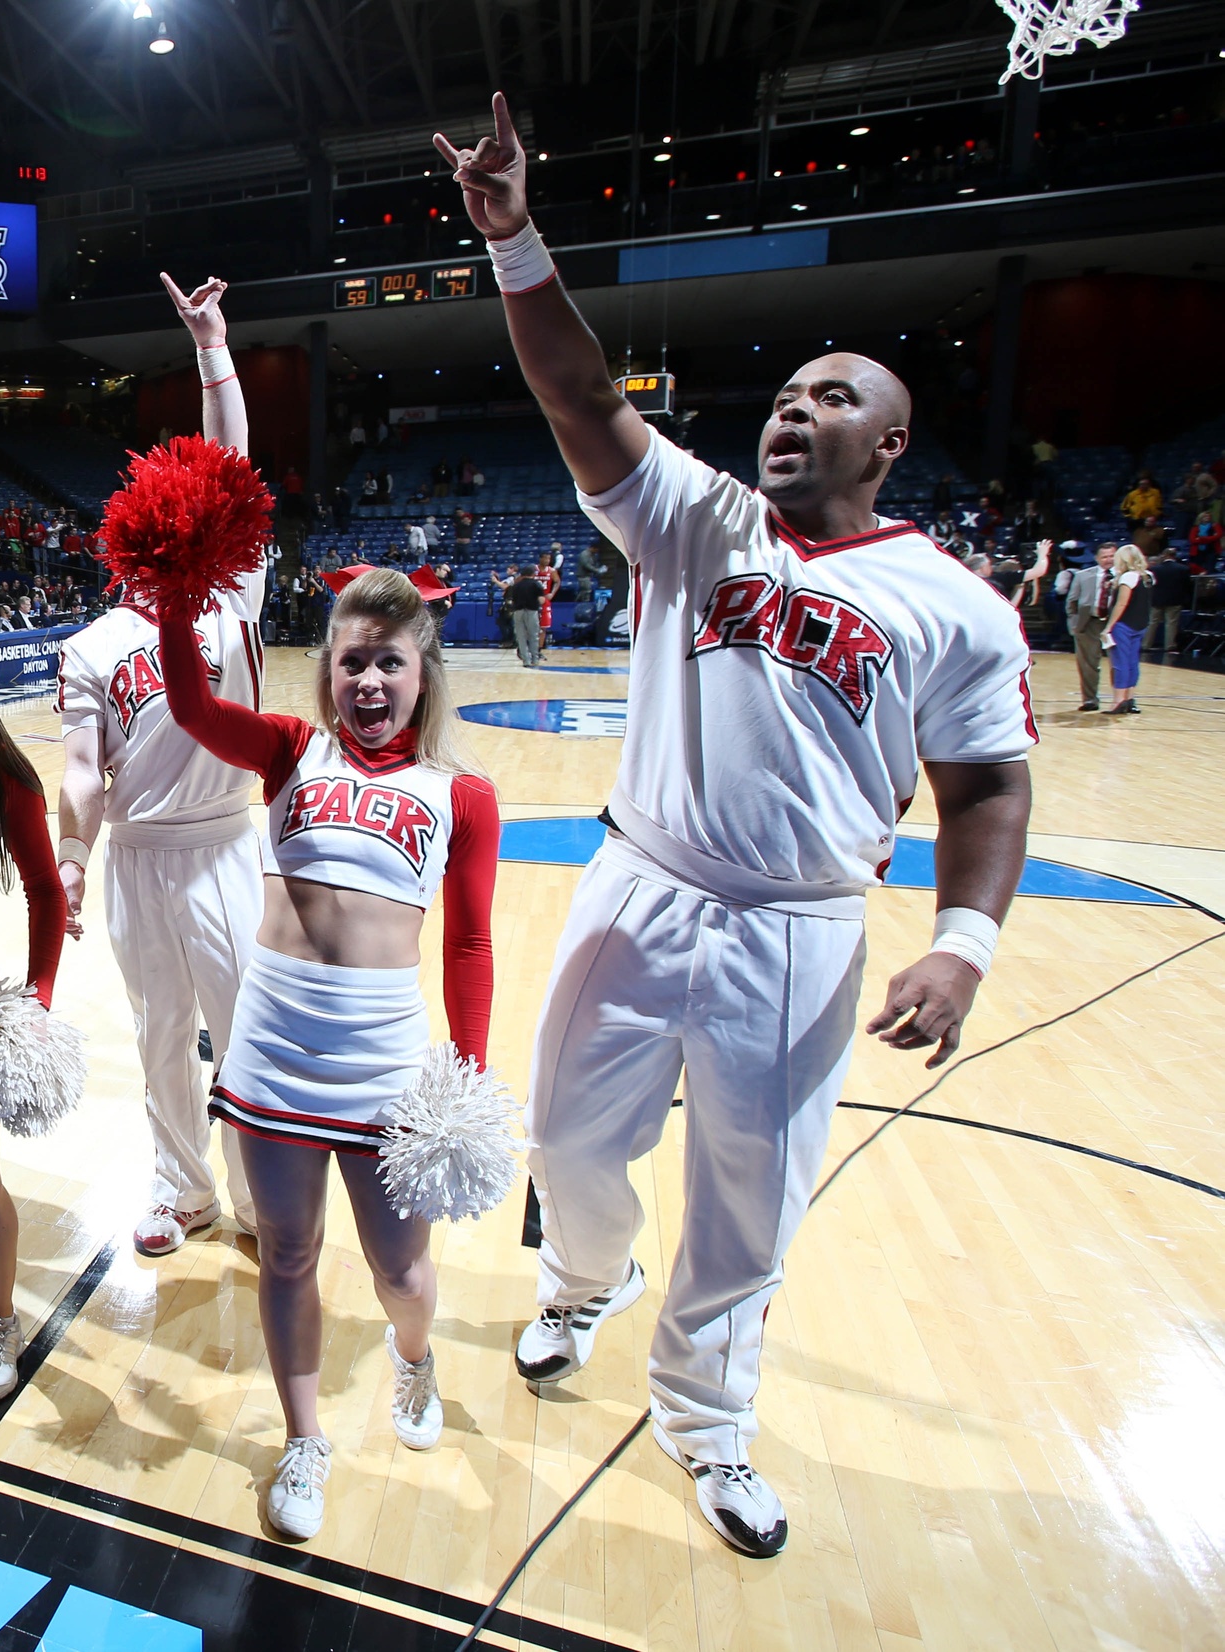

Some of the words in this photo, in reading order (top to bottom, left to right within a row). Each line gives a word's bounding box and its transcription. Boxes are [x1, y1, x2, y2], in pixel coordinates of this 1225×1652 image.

[414, 289, 423, 301] 2
[446, 281, 467, 296] 74
[347, 290, 367, 306] 59
[626, 378, 658, 391] 00.0
[959, 510, 981, 528] X
[687, 573, 893, 727] PACK
[23, 659, 49, 674] DAYTON
[278, 777, 438, 877] PACK
